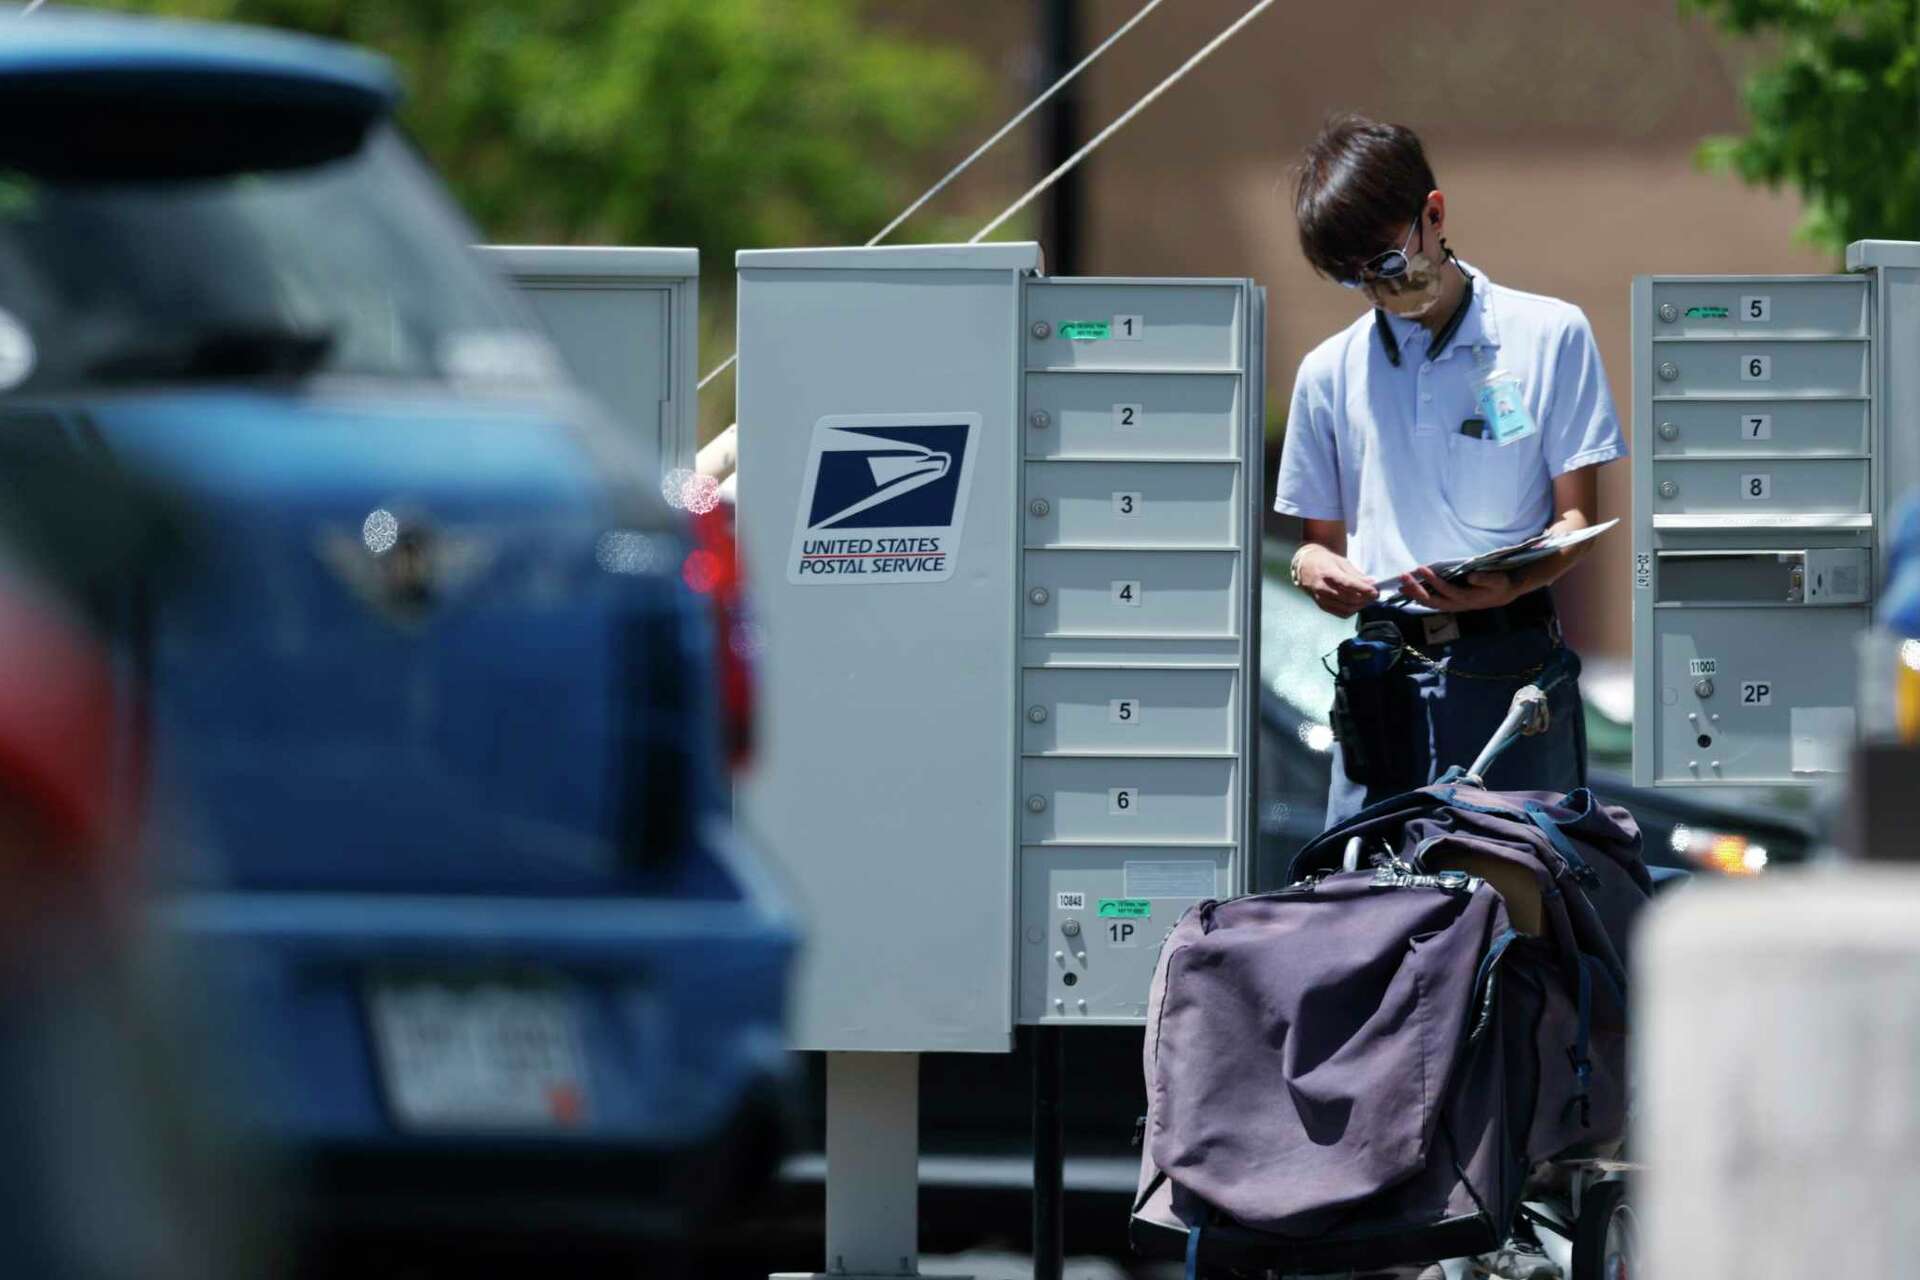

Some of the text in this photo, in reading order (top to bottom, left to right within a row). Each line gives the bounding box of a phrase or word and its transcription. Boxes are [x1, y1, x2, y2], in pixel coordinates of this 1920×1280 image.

[1750, 300, 1763, 318] 5
[1123, 318, 1133, 336] 1
[1750, 359, 1762, 377] 6
[1122, 408, 1134, 425] 2
[1750, 419, 1763, 436] 7
[1750, 478, 1762, 496] 8
[1121, 495, 1133, 514] 3
[803, 537, 940, 555] UNITED STATES
[800, 557, 945, 575] POSTAL SERVICE
[1119, 584, 1133, 602] 4
[1744, 684, 1770, 703] 2P
[1119, 702, 1131, 720] 5
[1117, 791, 1129, 809] 6
[1109, 923, 1134, 942] 1P
